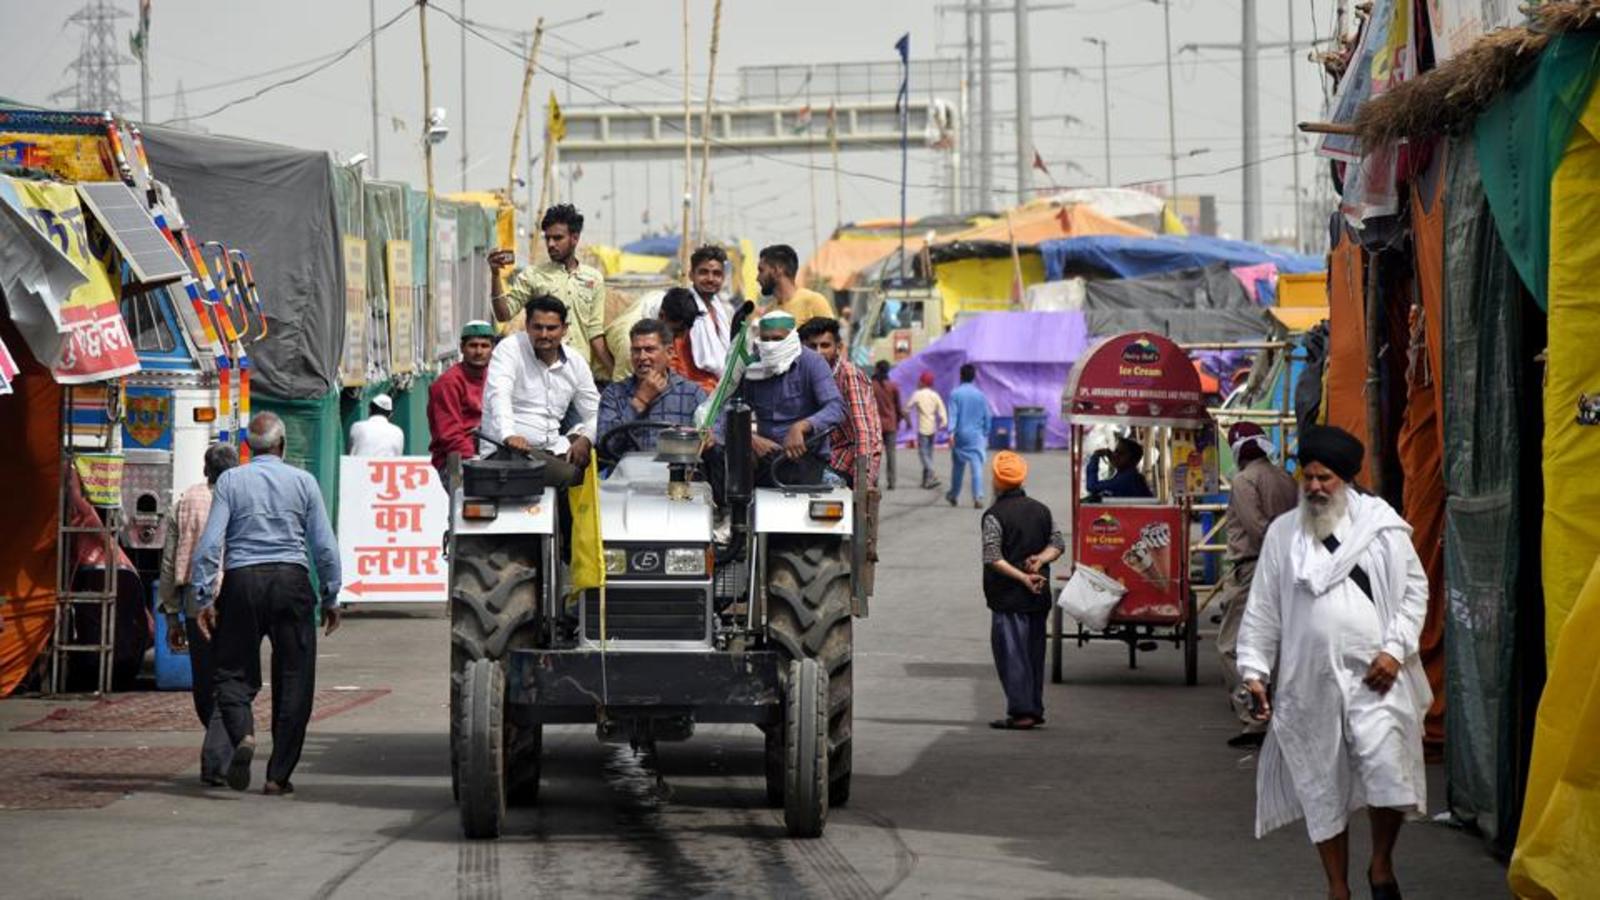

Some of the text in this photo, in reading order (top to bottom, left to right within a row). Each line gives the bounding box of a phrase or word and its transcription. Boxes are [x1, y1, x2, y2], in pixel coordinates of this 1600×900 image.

[1119, 365, 1163, 377] Ice Cream
[368, 461, 433, 500] गुरु
[371, 503, 426, 533] का
[354, 537, 441, 576] लंगर
